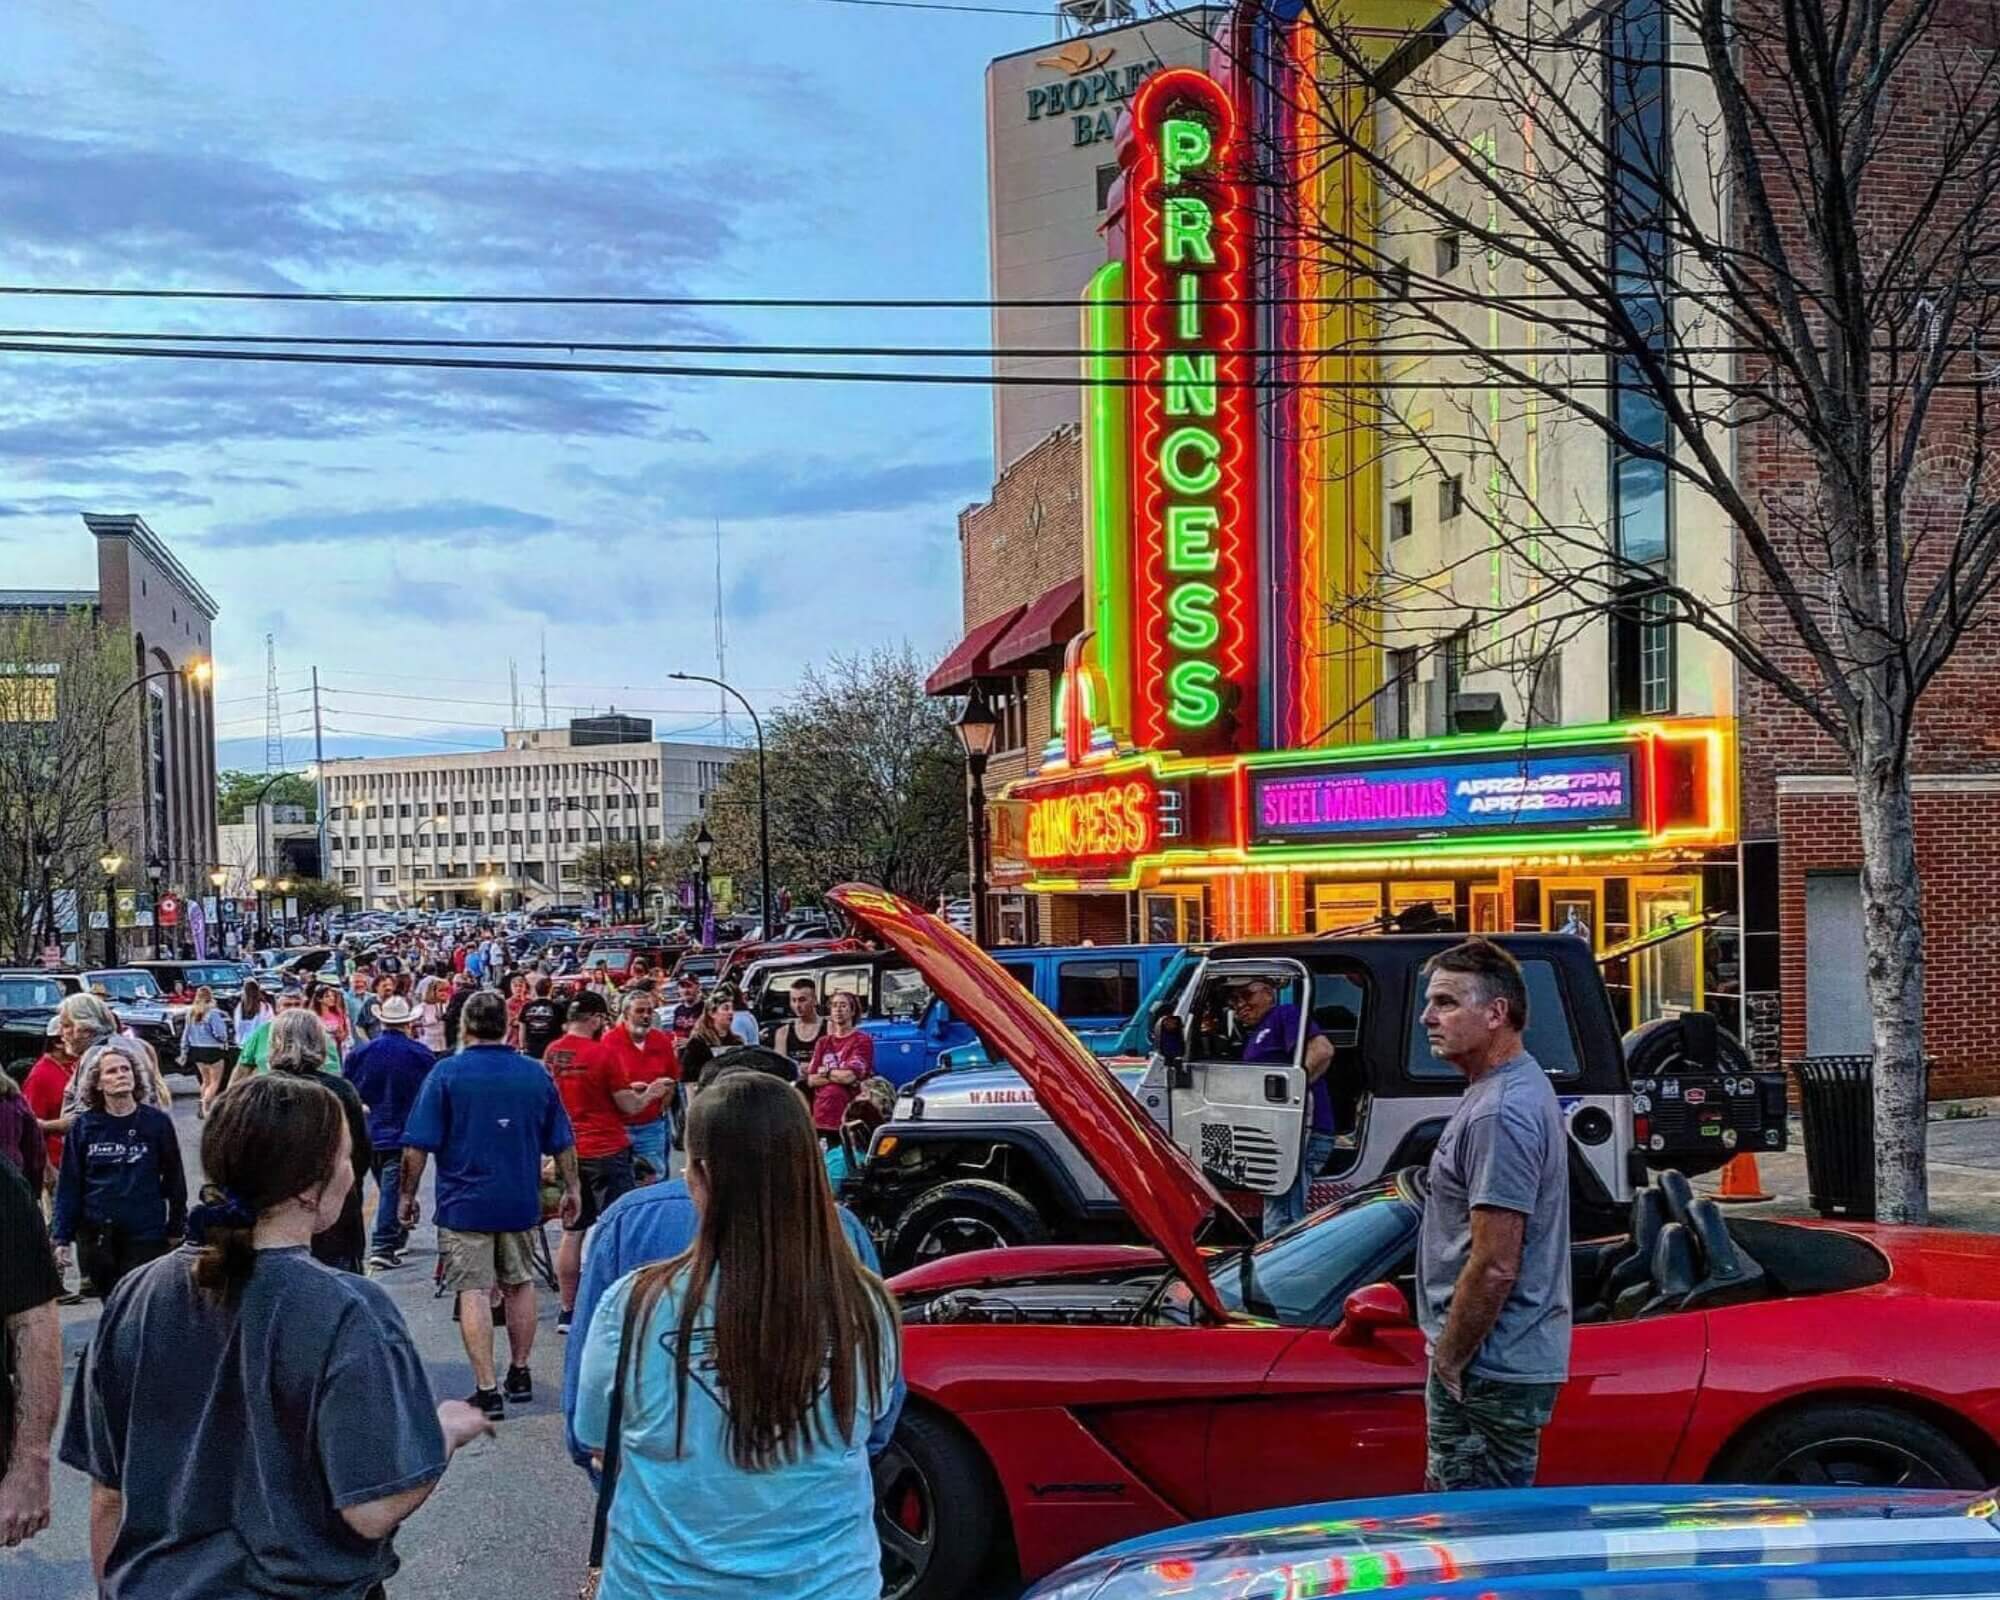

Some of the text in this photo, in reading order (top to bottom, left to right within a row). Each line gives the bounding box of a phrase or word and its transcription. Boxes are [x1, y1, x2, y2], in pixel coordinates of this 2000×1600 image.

[1071, 106, 1124, 147] BA
[1160, 119, 1222, 727] PRINCESS
[1263, 778, 1447, 826] STEEL MAGNOLIAS
